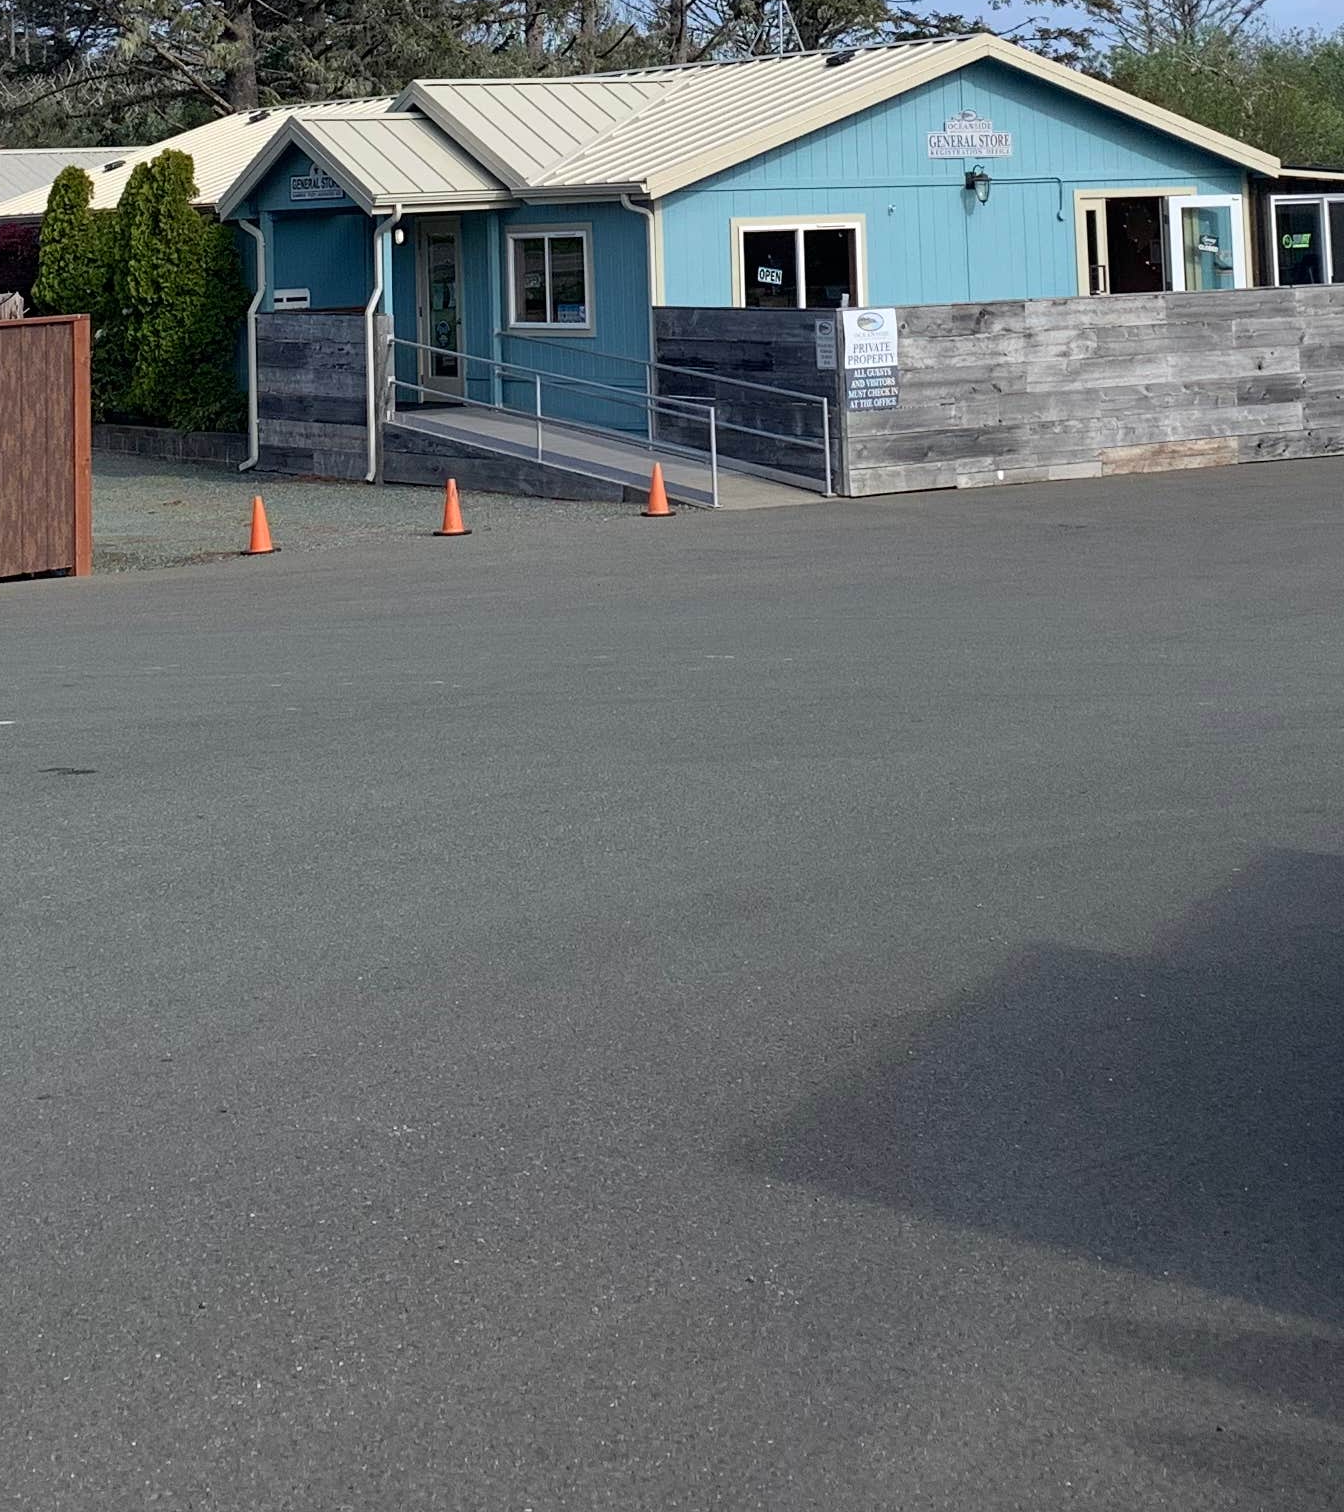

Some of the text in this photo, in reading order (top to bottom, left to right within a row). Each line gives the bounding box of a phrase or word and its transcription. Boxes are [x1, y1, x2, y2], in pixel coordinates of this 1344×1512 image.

[929, 134, 1010, 148] GENERAL STORE
[321, 177, 341, 189] STOR
[759, 268, 781, 283] OPEN
[853, 342, 891, 353] PRIVATE
[848, 353, 895, 365] PROPERTY
[854, 367, 892, 378] ALL GUESTS
[850, 376, 896, 389] AND VISITORS
[848, 386, 899, 399] MUST CHECK IN
[850, 397, 897, 408] AT THE OFFICE
